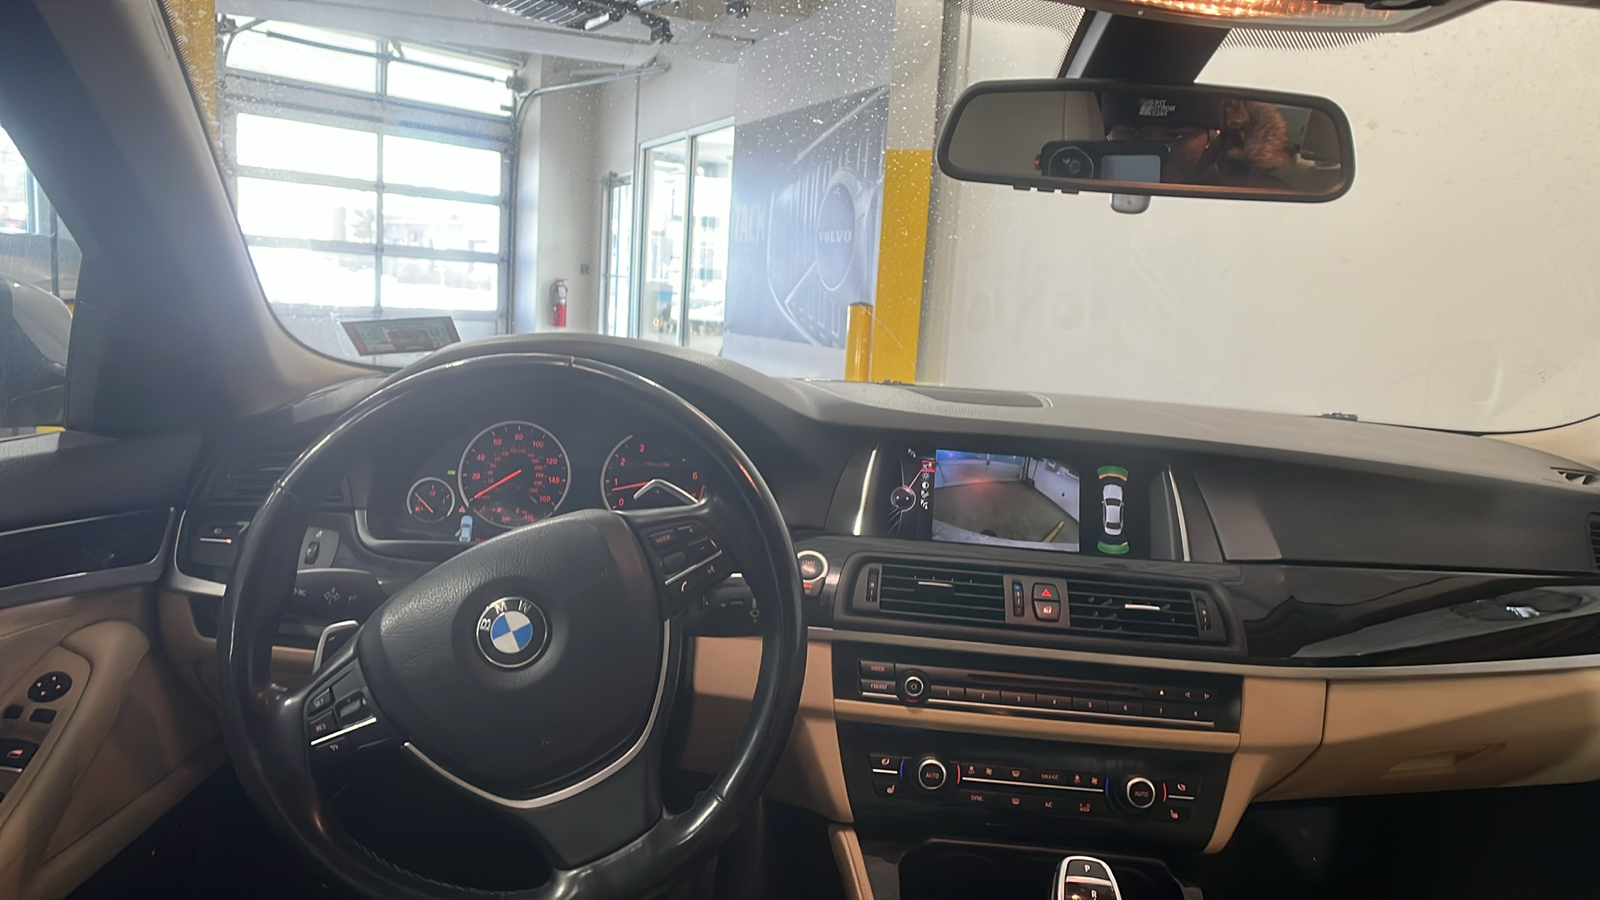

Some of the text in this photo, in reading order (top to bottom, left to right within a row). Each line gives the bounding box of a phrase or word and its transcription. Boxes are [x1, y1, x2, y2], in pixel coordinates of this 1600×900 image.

[818, 229, 852, 244] VOLVO
[514, 433, 524, 441] 80
[493, 438, 503, 446] 60
[532, 440, 544, 448] 100
[545, 457, 558, 465] 120
[471, 472, 481, 480] 20
[548, 476, 560, 484] 140
[539, 495, 551, 503] 160
[618, 497, 625, 506] 0
[479, 599, 532, 632] BMW
[925, 772, 940, 780] AUTO
[970, 794, 984, 802] SYNC
[1134, 790, 1149, 798] AUTO
[1084, 863, 1091, 873] P
